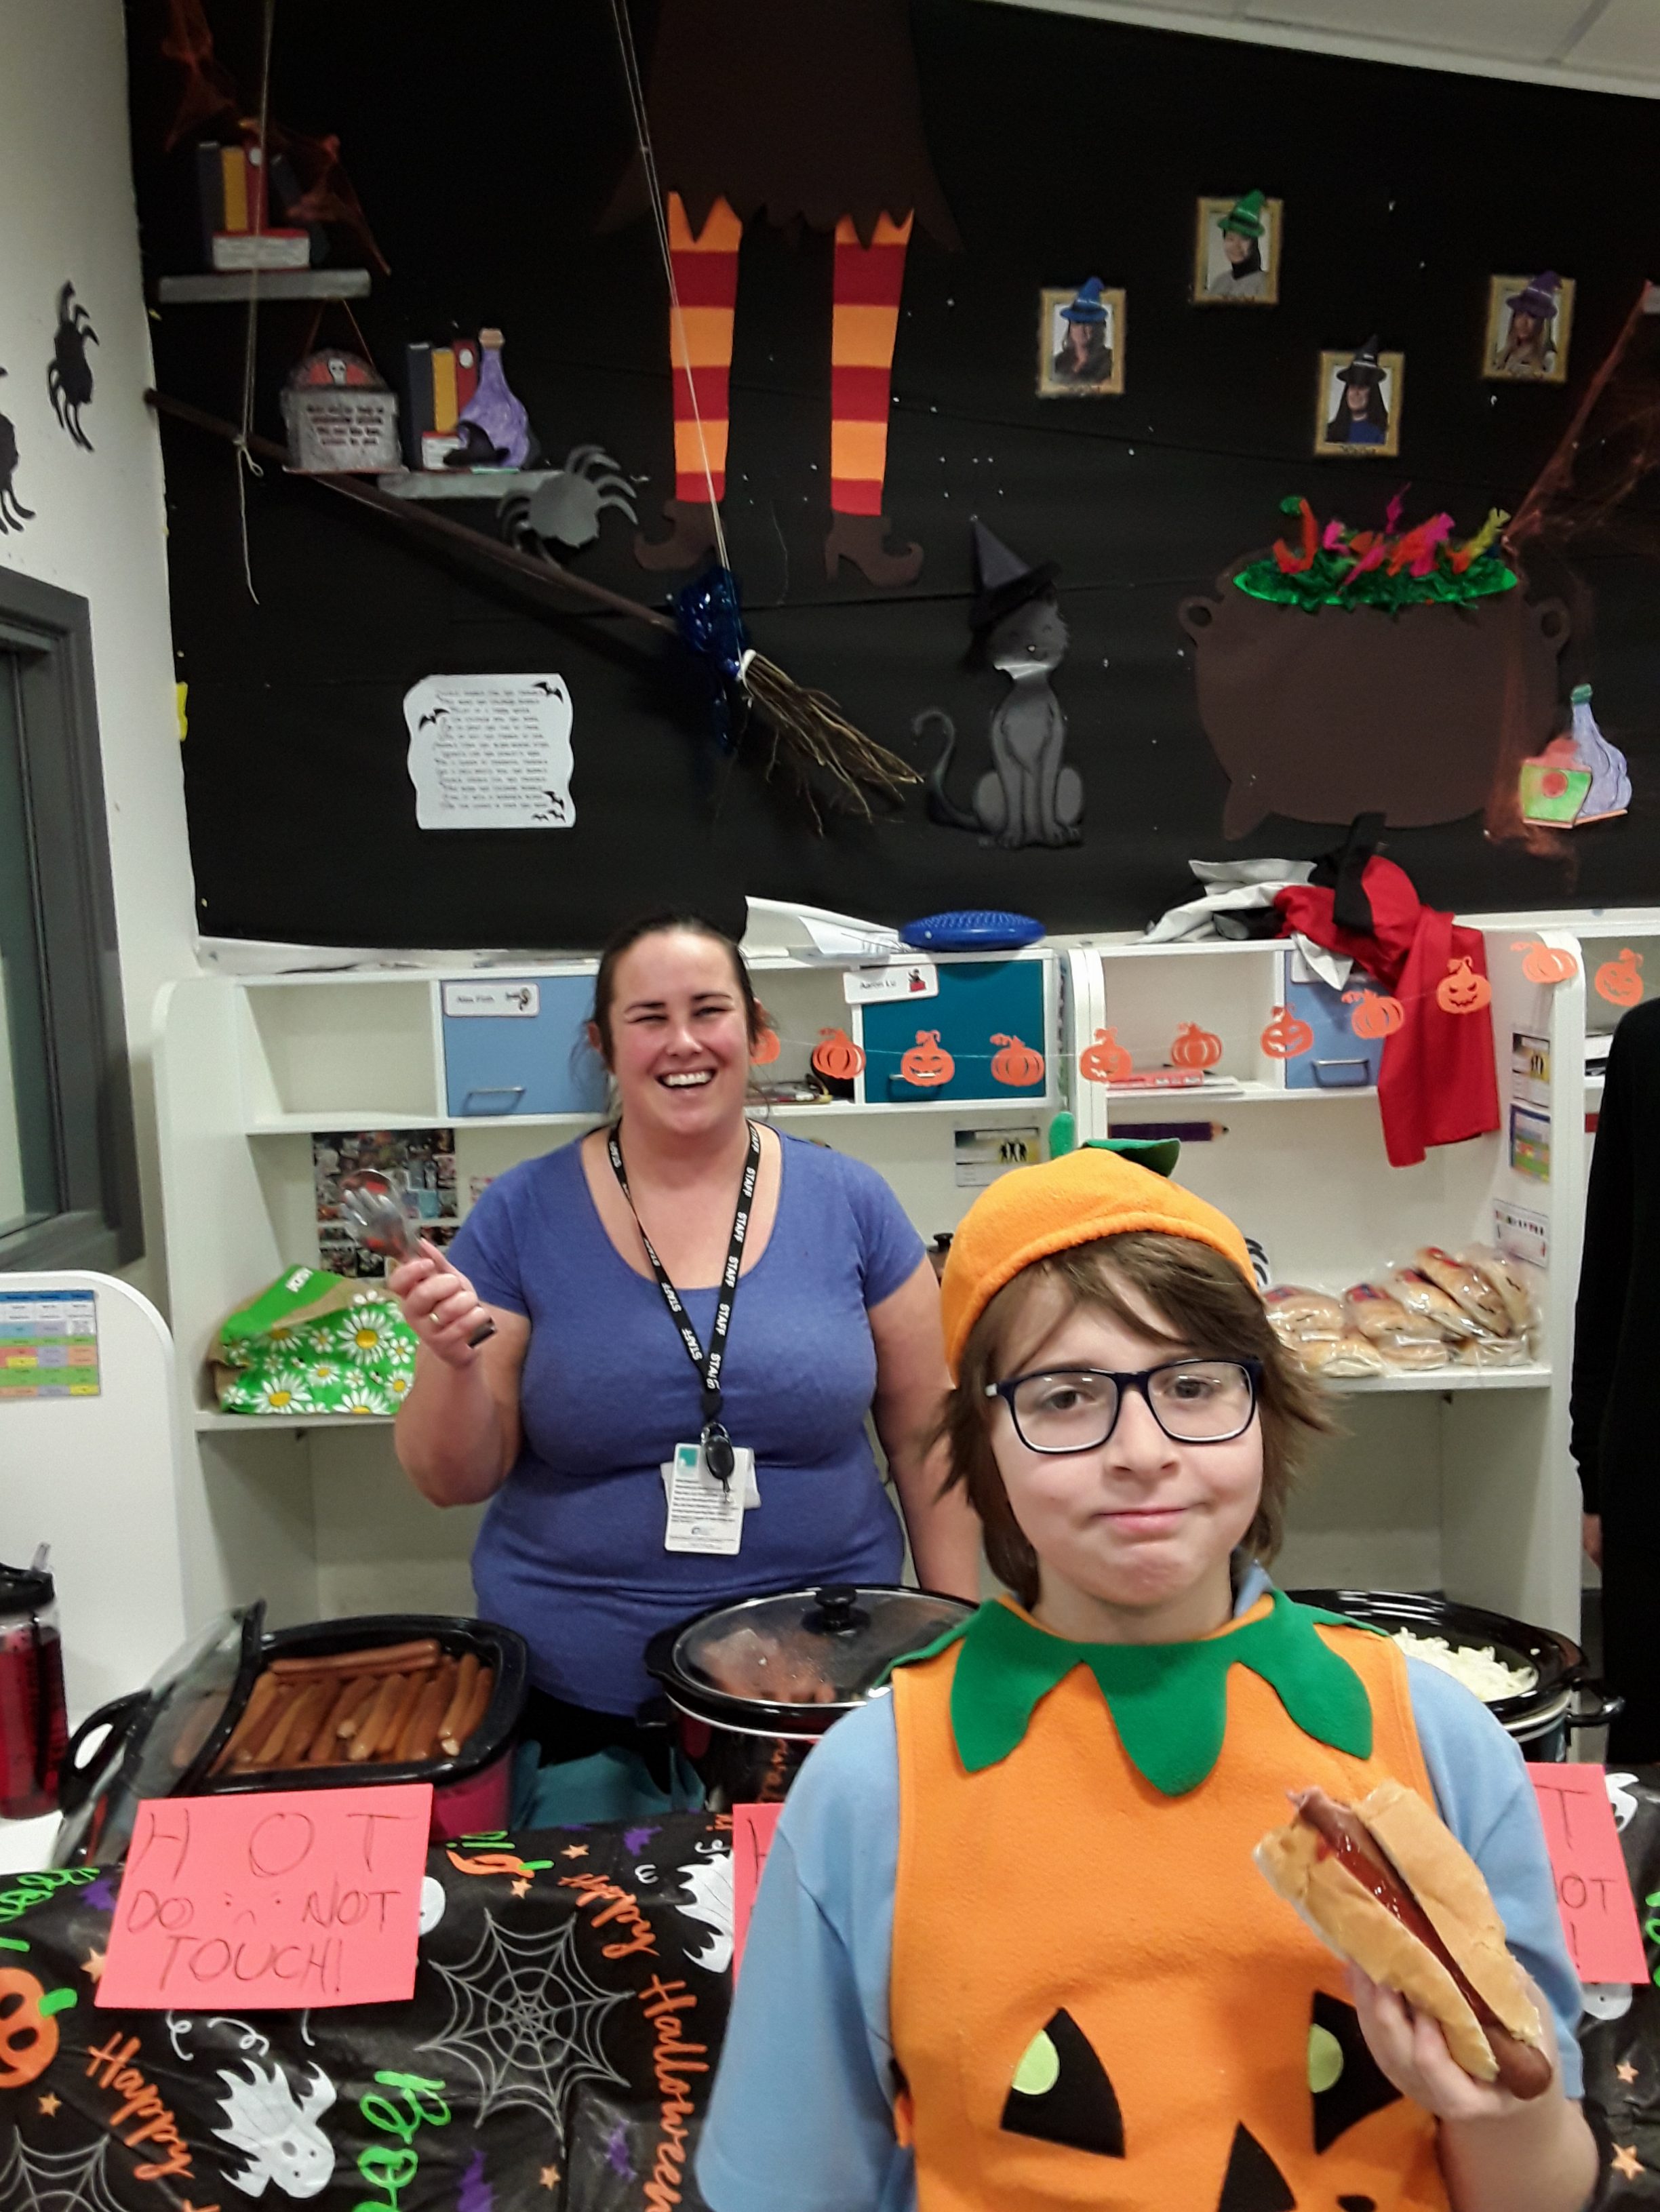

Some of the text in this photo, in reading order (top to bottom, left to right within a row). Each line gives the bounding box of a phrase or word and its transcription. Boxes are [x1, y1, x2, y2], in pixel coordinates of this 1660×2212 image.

[743, 1167, 756, 1198] STAFF
[733, 1211, 747, 1243] STAFF
[724, 1255, 739, 1288] STAFF
[661, 1282, 682, 1312] STAFF
[715, 1302, 730, 1337] STAFF
[681, 1327, 704, 1361] STAFF
[132, 1808, 419, 1883] HOT
[127, 1874, 402, 1933] DO NOT
[159, 1934, 343, 1993] TOUCH!
[85, 2032, 195, 2181] Happy
